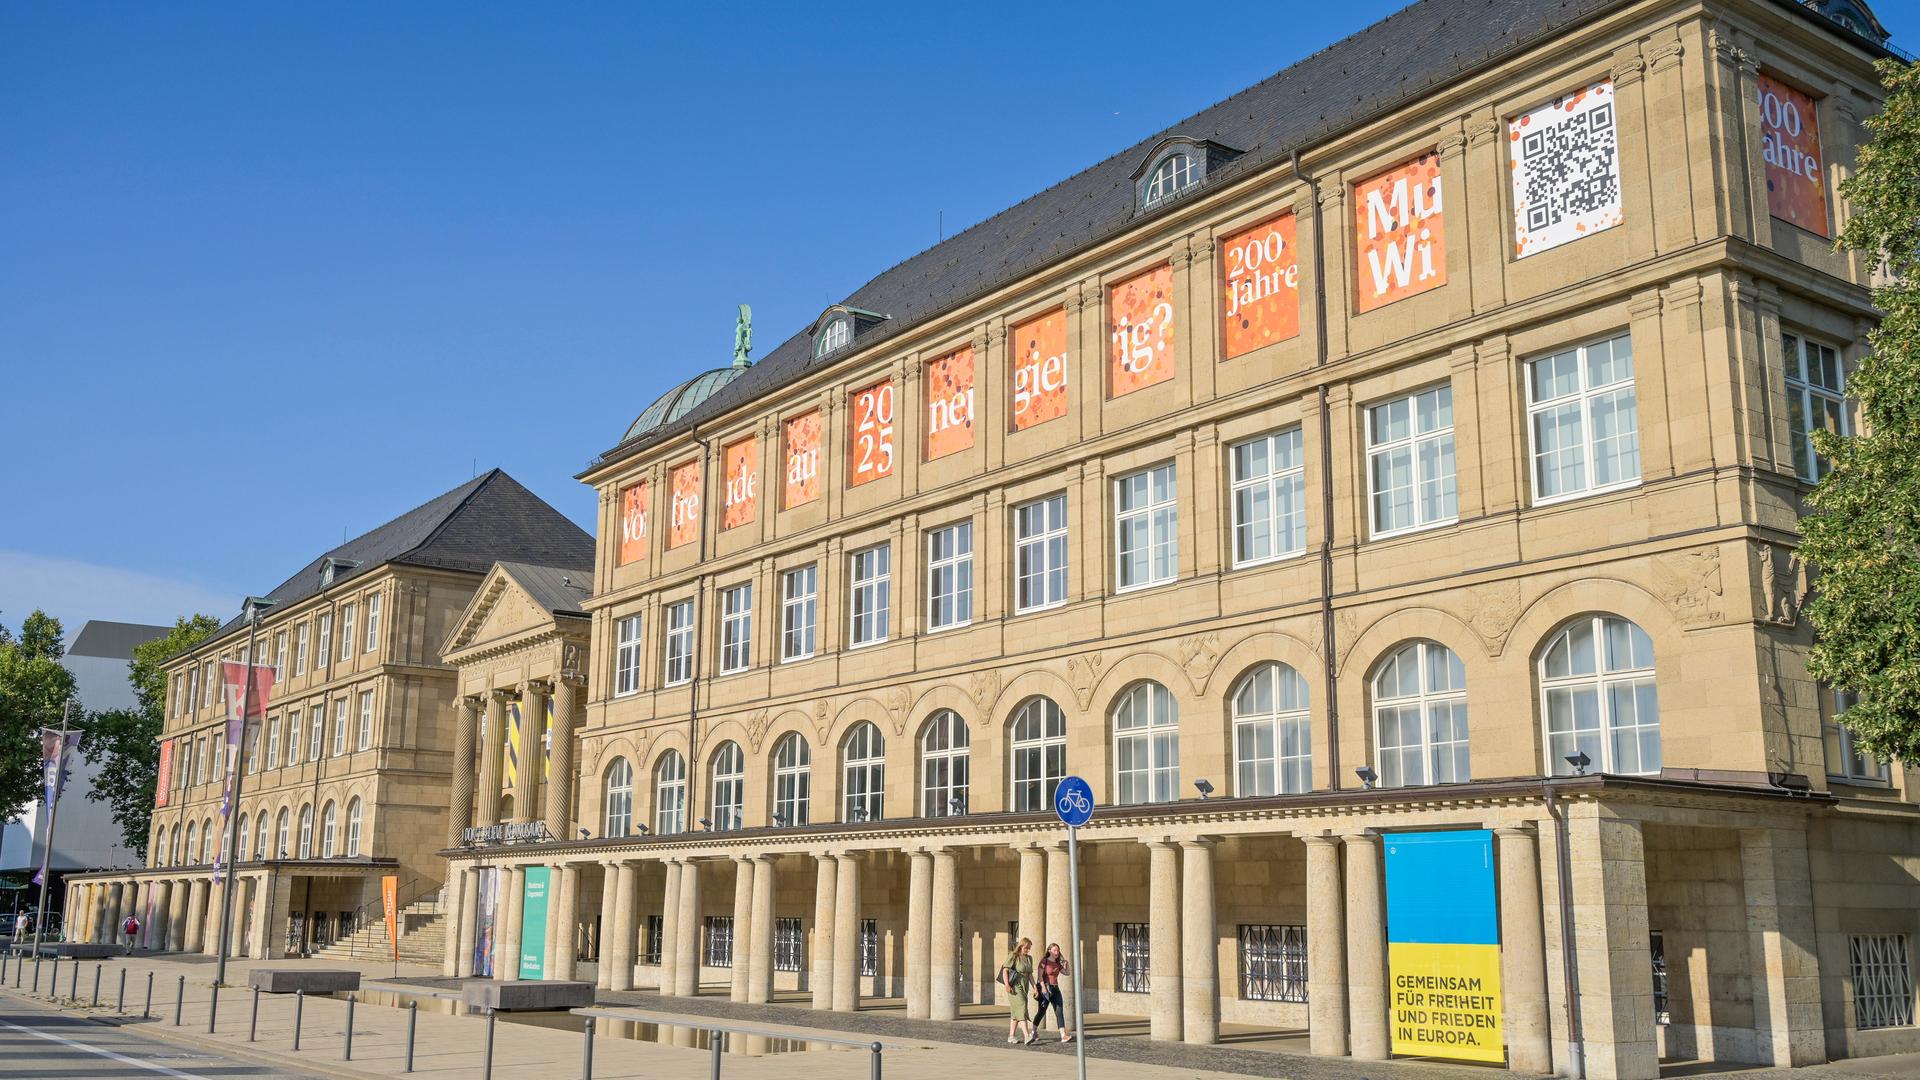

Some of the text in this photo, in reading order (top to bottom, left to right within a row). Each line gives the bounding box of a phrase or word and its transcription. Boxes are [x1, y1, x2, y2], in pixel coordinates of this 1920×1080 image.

[1367, 176, 1442, 240] Mu
[1229, 231, 1283, 278] 200
[1368, 228, 1436, 295] Wi
[1227, 264, 1297, 317] Jahre
[859, 386, 894, 432] 20
[858, 426, 893, 473] 25
[1396, 975, 1481, 992] GEMEINSAM
[1397, 990, 1494, 1010] FÜR FREIHEIT
[1398, 1010, 1496, 1029] UND FRIEDEN
[1398, 1027, 1481, 1046] IN EUROPA.
